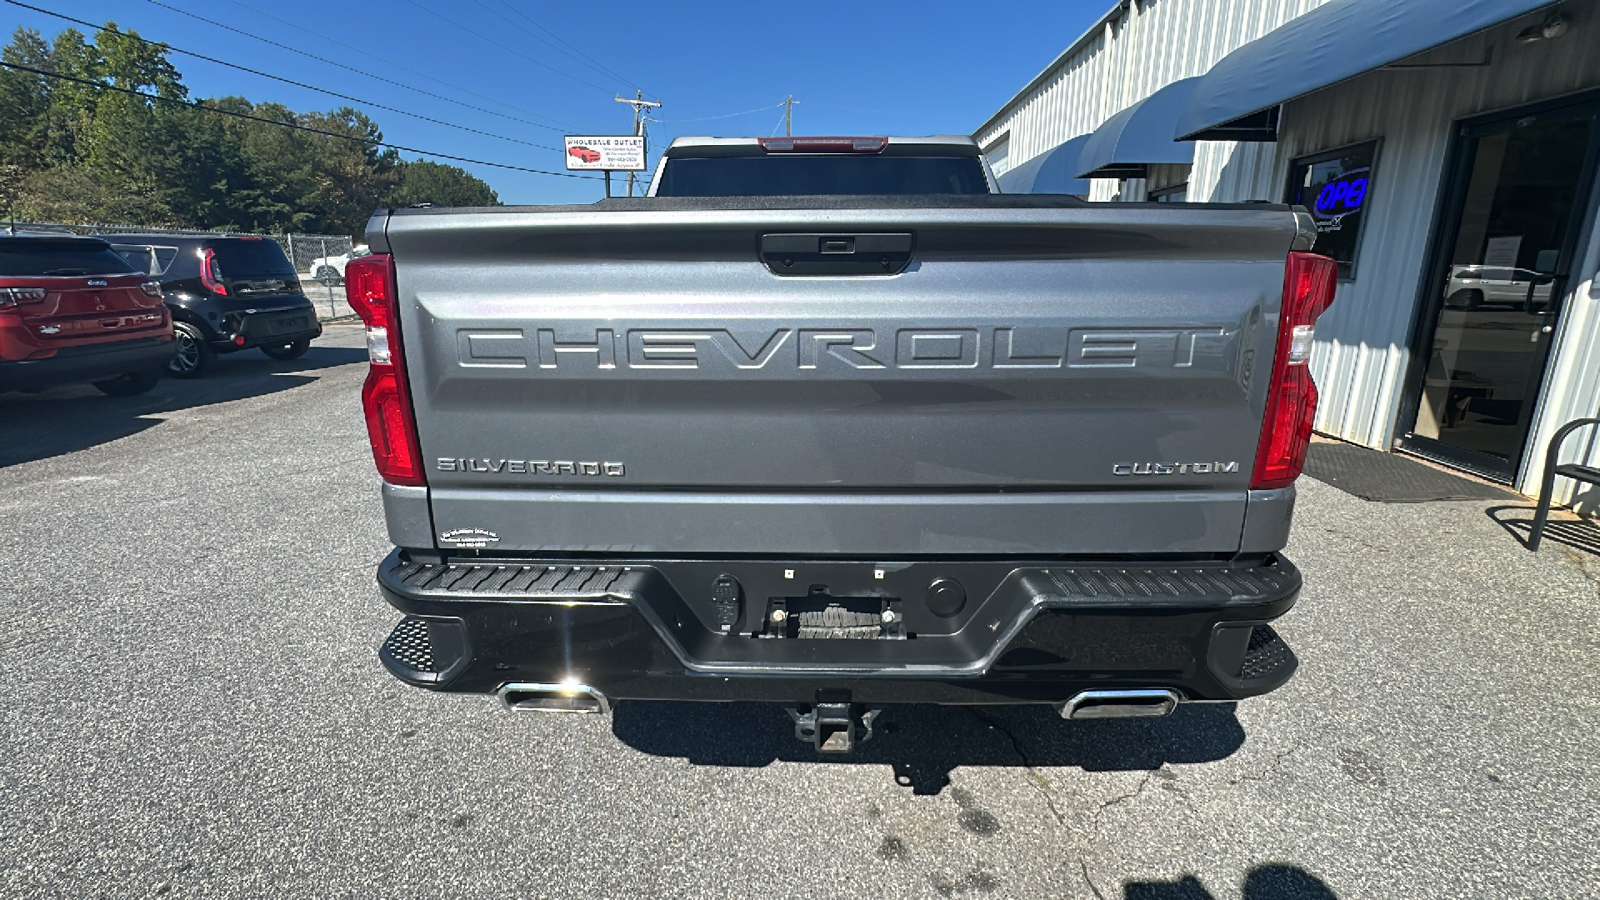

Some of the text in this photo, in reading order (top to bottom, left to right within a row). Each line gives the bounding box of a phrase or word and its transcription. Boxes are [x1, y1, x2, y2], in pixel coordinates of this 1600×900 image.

[456, 326, 1227, 370] CHEVROLET
[436, 457, 625, 476] SILVERADO
[1112, 461, 1240, 475] CUSTOM
